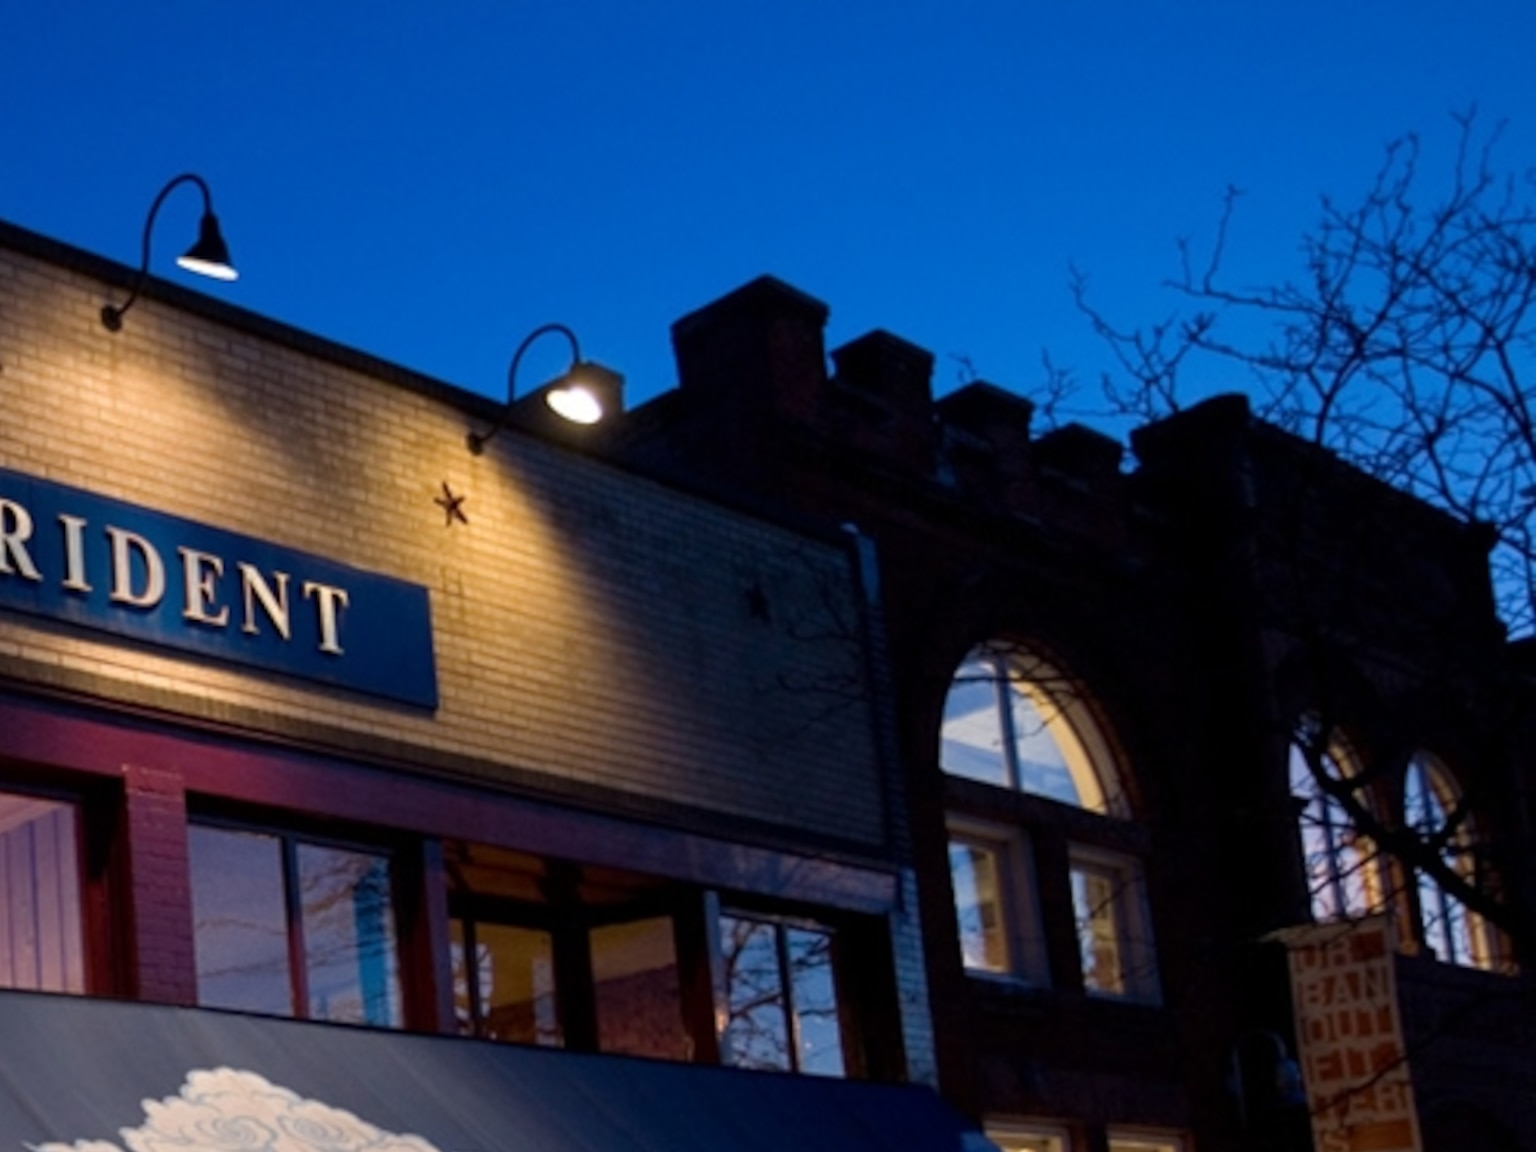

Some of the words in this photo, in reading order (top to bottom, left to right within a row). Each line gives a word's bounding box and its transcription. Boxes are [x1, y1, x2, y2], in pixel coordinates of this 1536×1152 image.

[1298, 964, 1390, 1010] BAN
[1302, 1003, 1395, 1046] OUT
[1306, 1040, 1400, 1085] FIT
